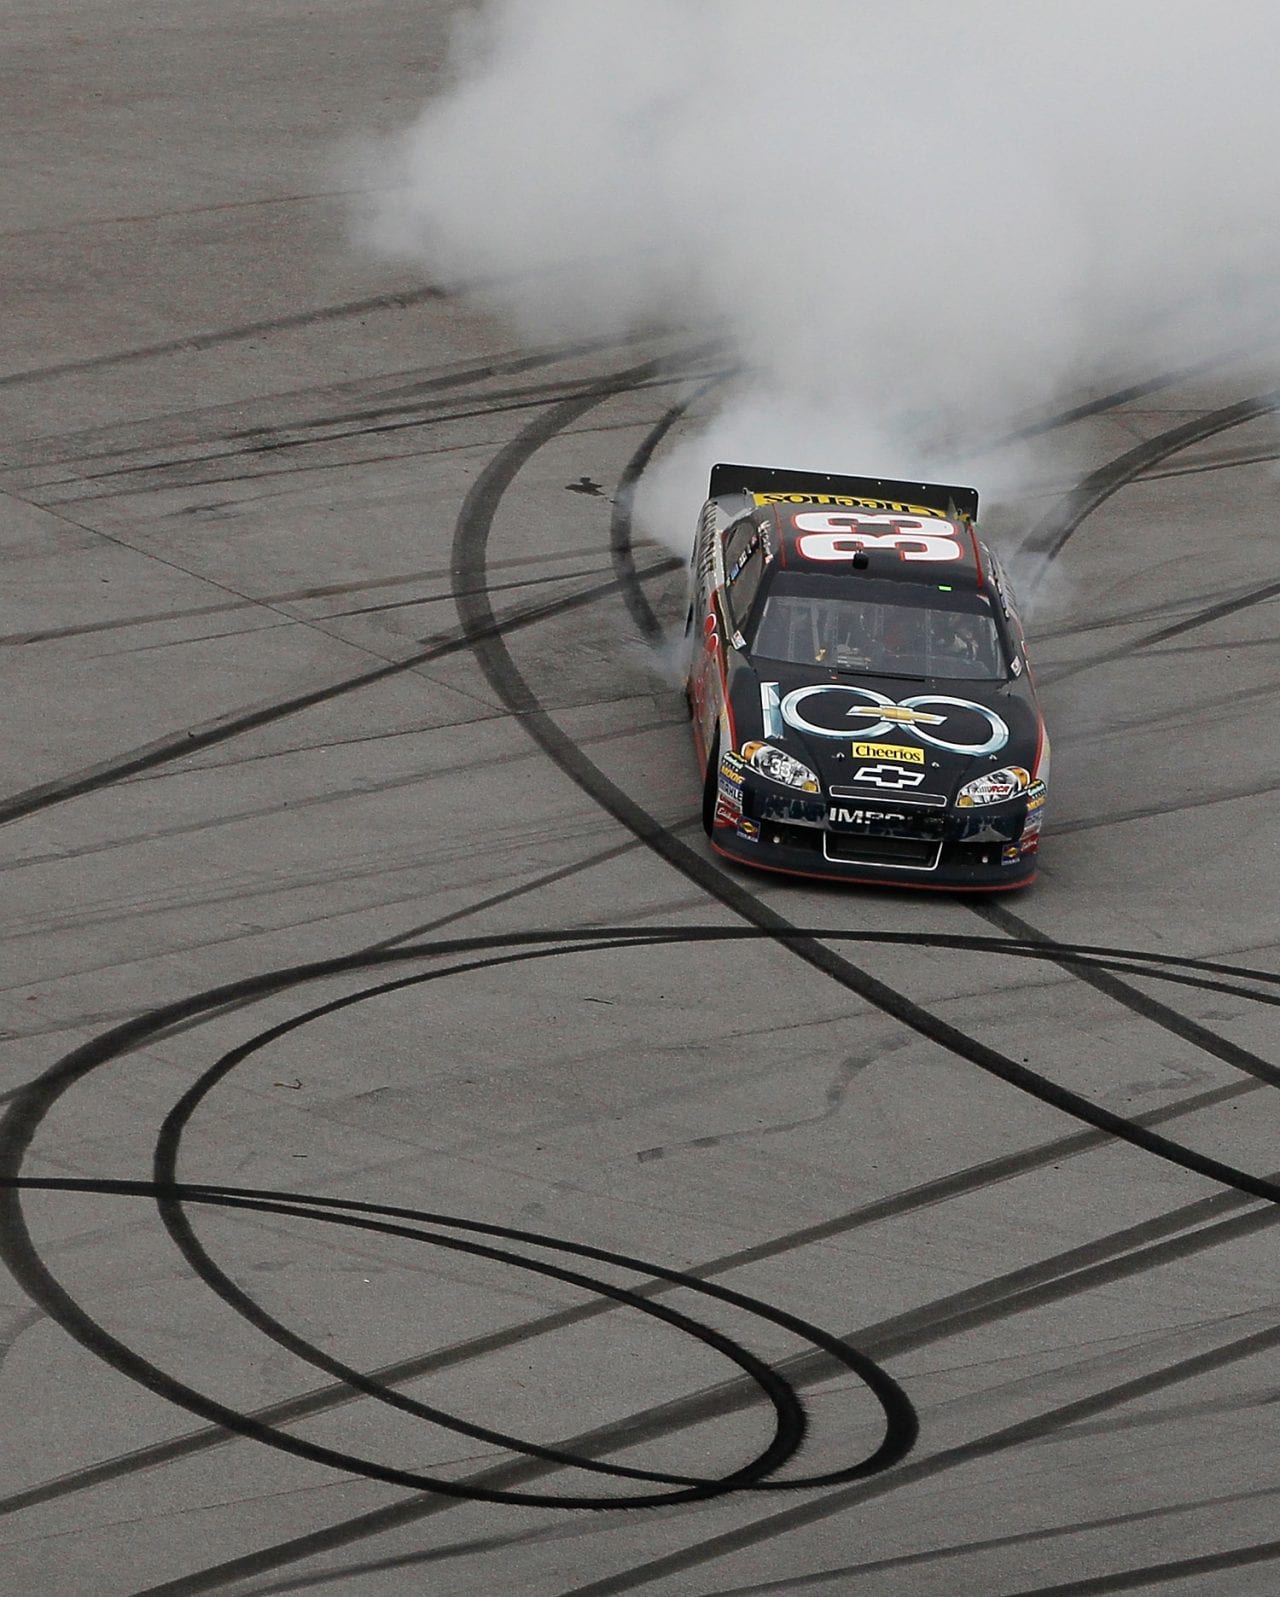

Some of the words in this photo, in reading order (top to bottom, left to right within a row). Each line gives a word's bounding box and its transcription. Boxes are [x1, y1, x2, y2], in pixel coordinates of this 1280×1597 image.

[791, 511, 965, 562] 33
[760, 682, 1010, 757] 100
[769, 758, 792, 777] 33
[855, 745, 921, 762] Cheerios
